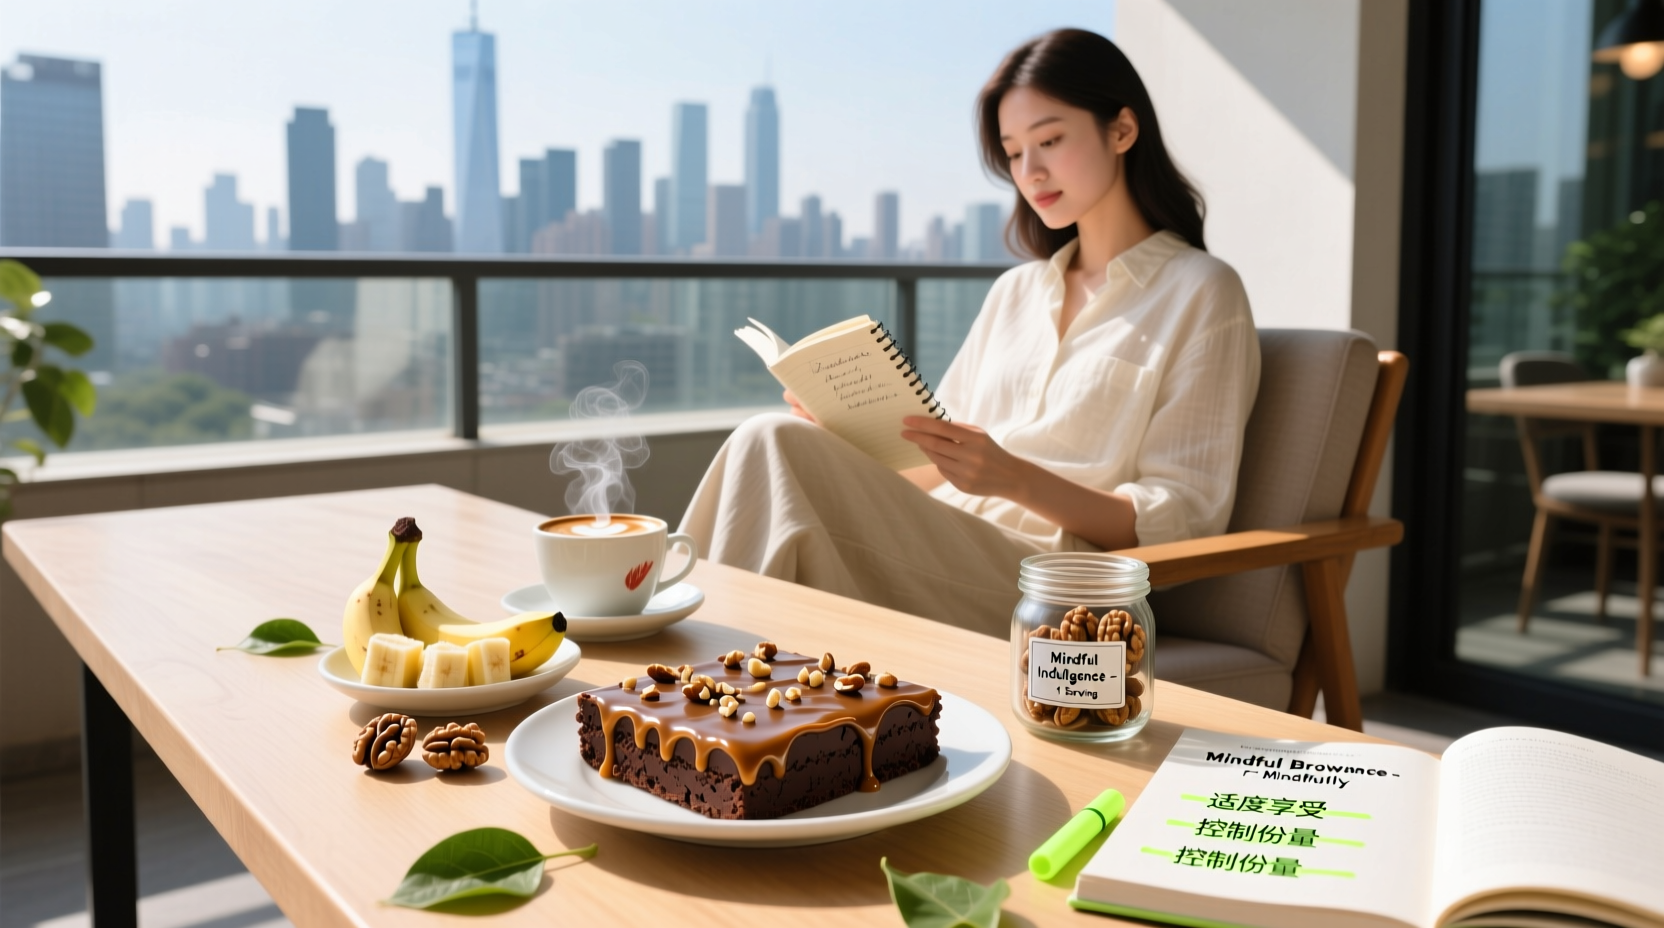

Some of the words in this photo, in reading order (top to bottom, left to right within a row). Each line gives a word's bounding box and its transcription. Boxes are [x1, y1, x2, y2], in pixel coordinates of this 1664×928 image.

[1051, 651, 1098, 666] Mindful
[1206, 751, 1283, 769] Mindful
[1207, 792, 1327, 819] 适度享受
[1195, 818, 1319, 848] 控制份量
[1173, 846, 1302, 878] 控制份量
